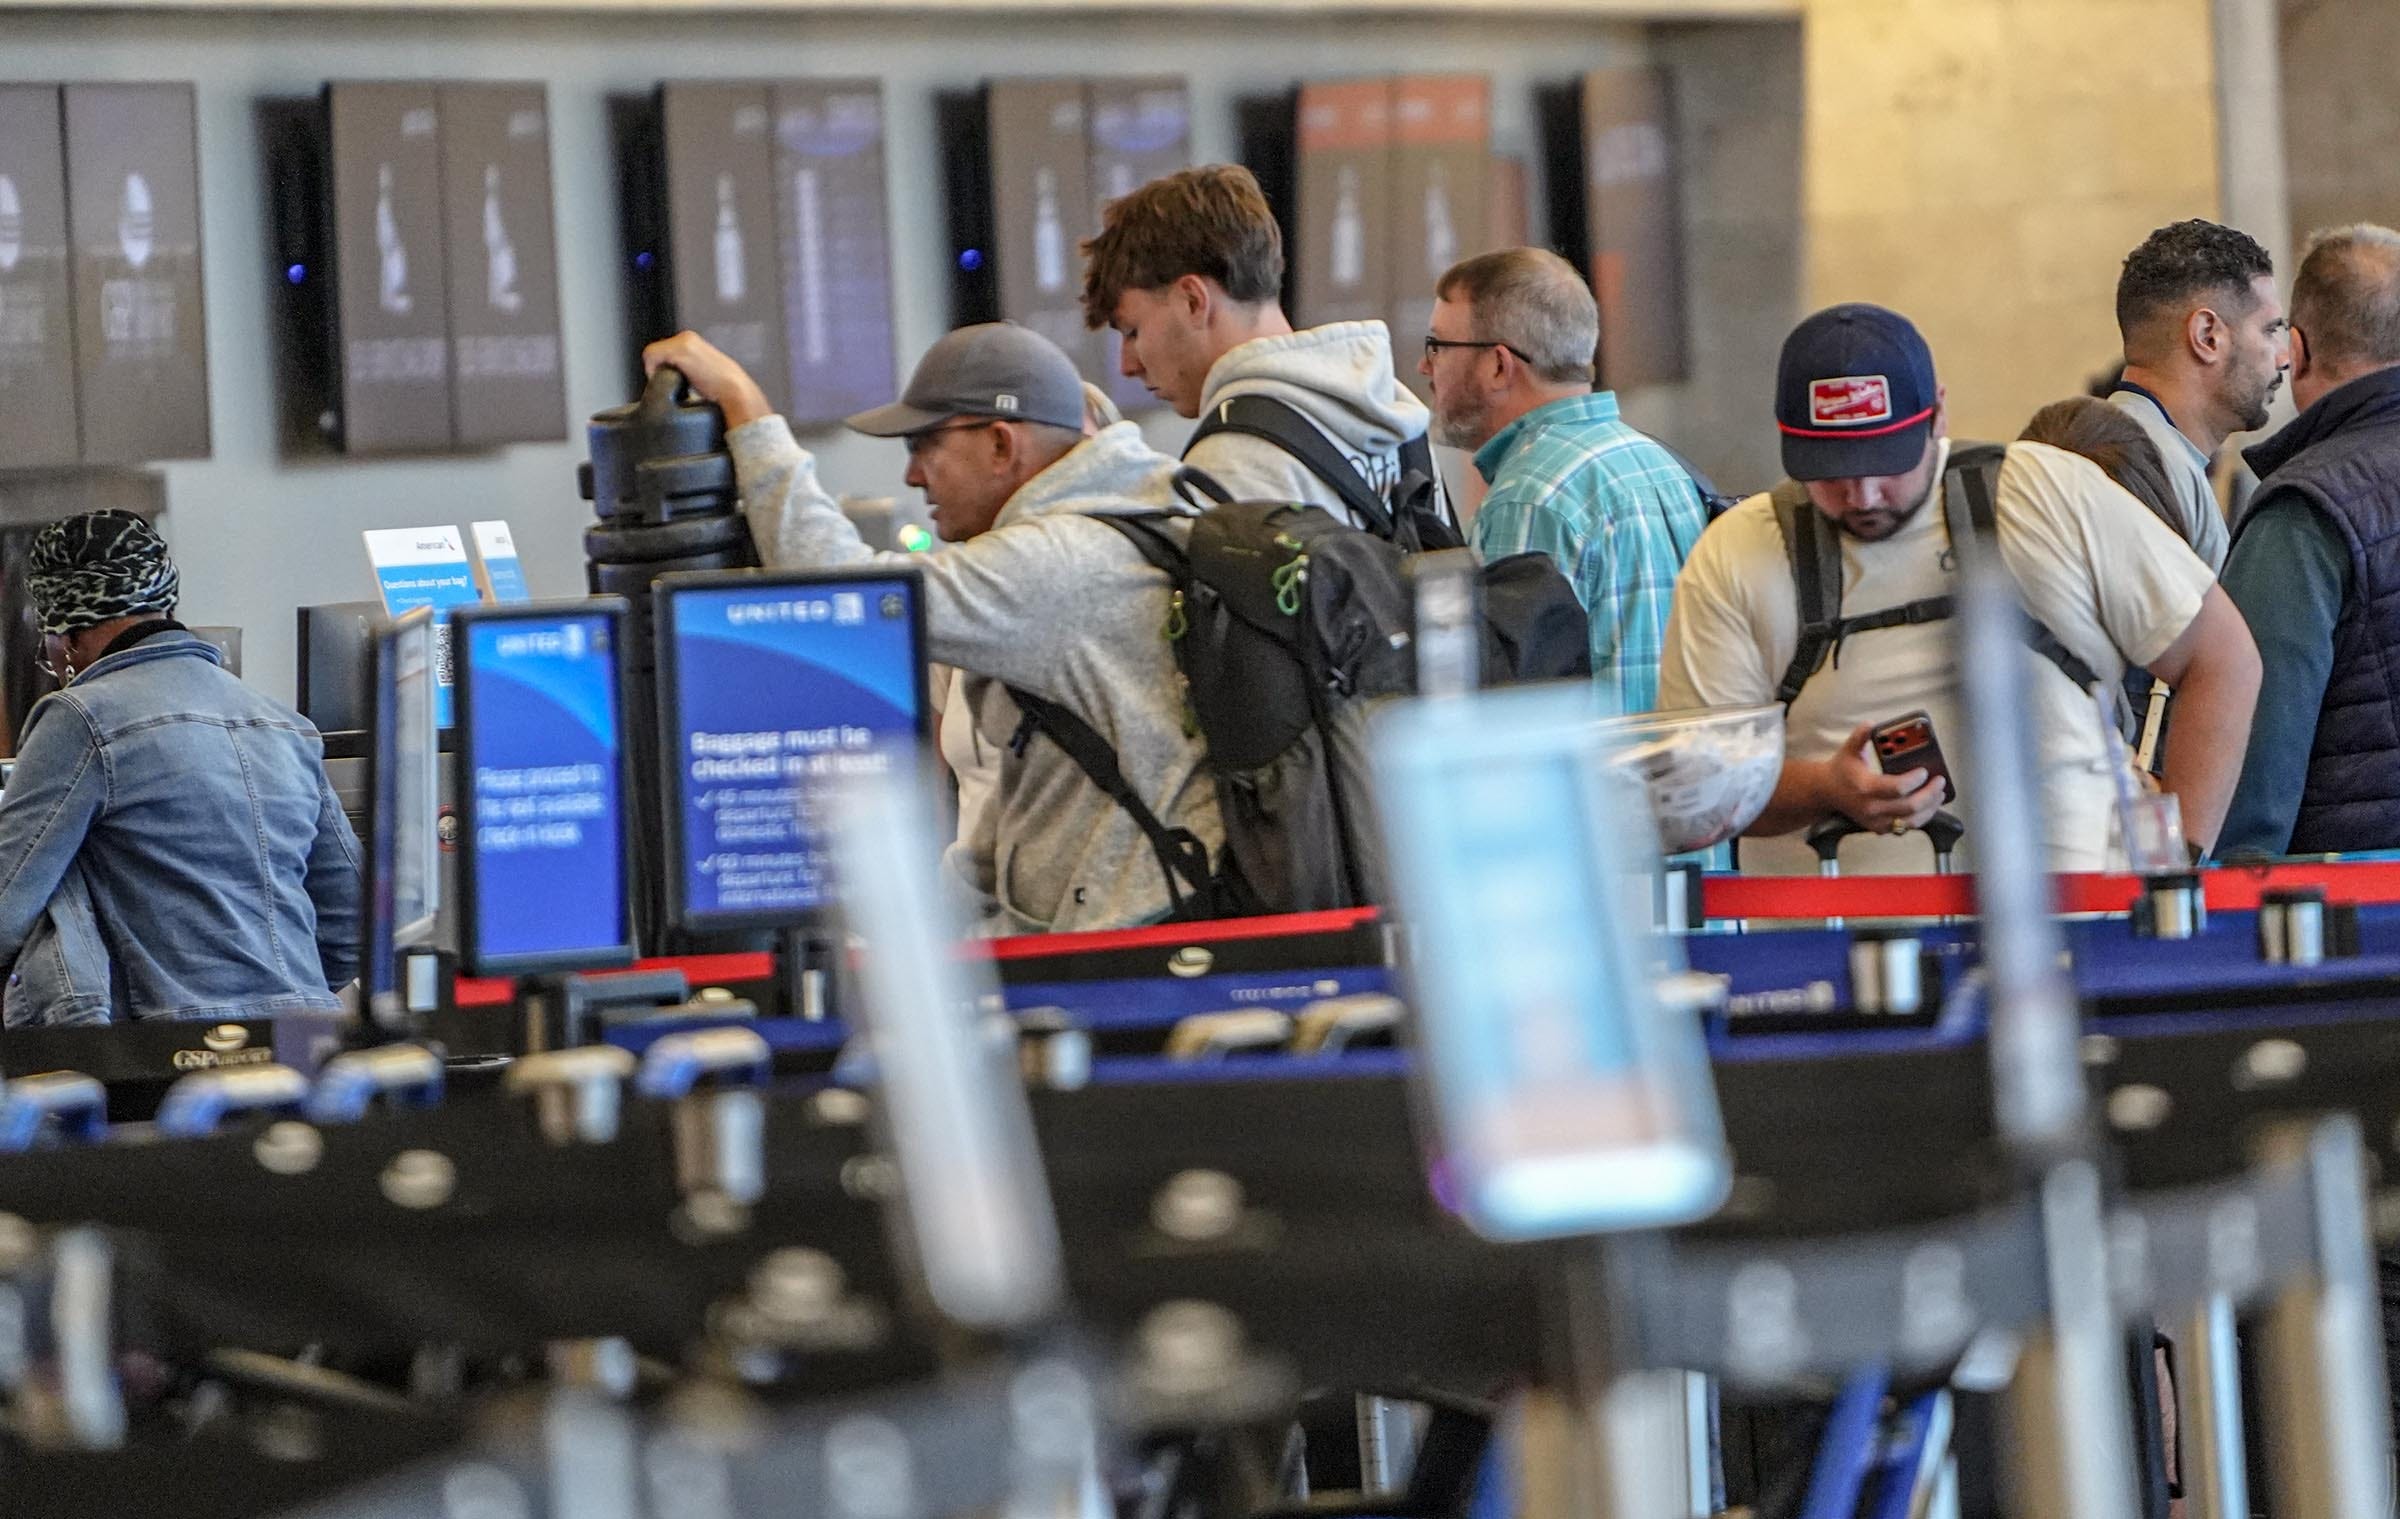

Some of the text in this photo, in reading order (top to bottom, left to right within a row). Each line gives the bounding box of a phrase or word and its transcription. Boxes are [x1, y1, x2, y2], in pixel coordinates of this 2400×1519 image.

[384, 576, 467, 590] Questions about your bag?
[727, 601, 831, 625] UNITED
[692, 724, 871, 757] Baggage must be
[692, 757, 780, 781] checked
[782, 752, 804, 775] in
